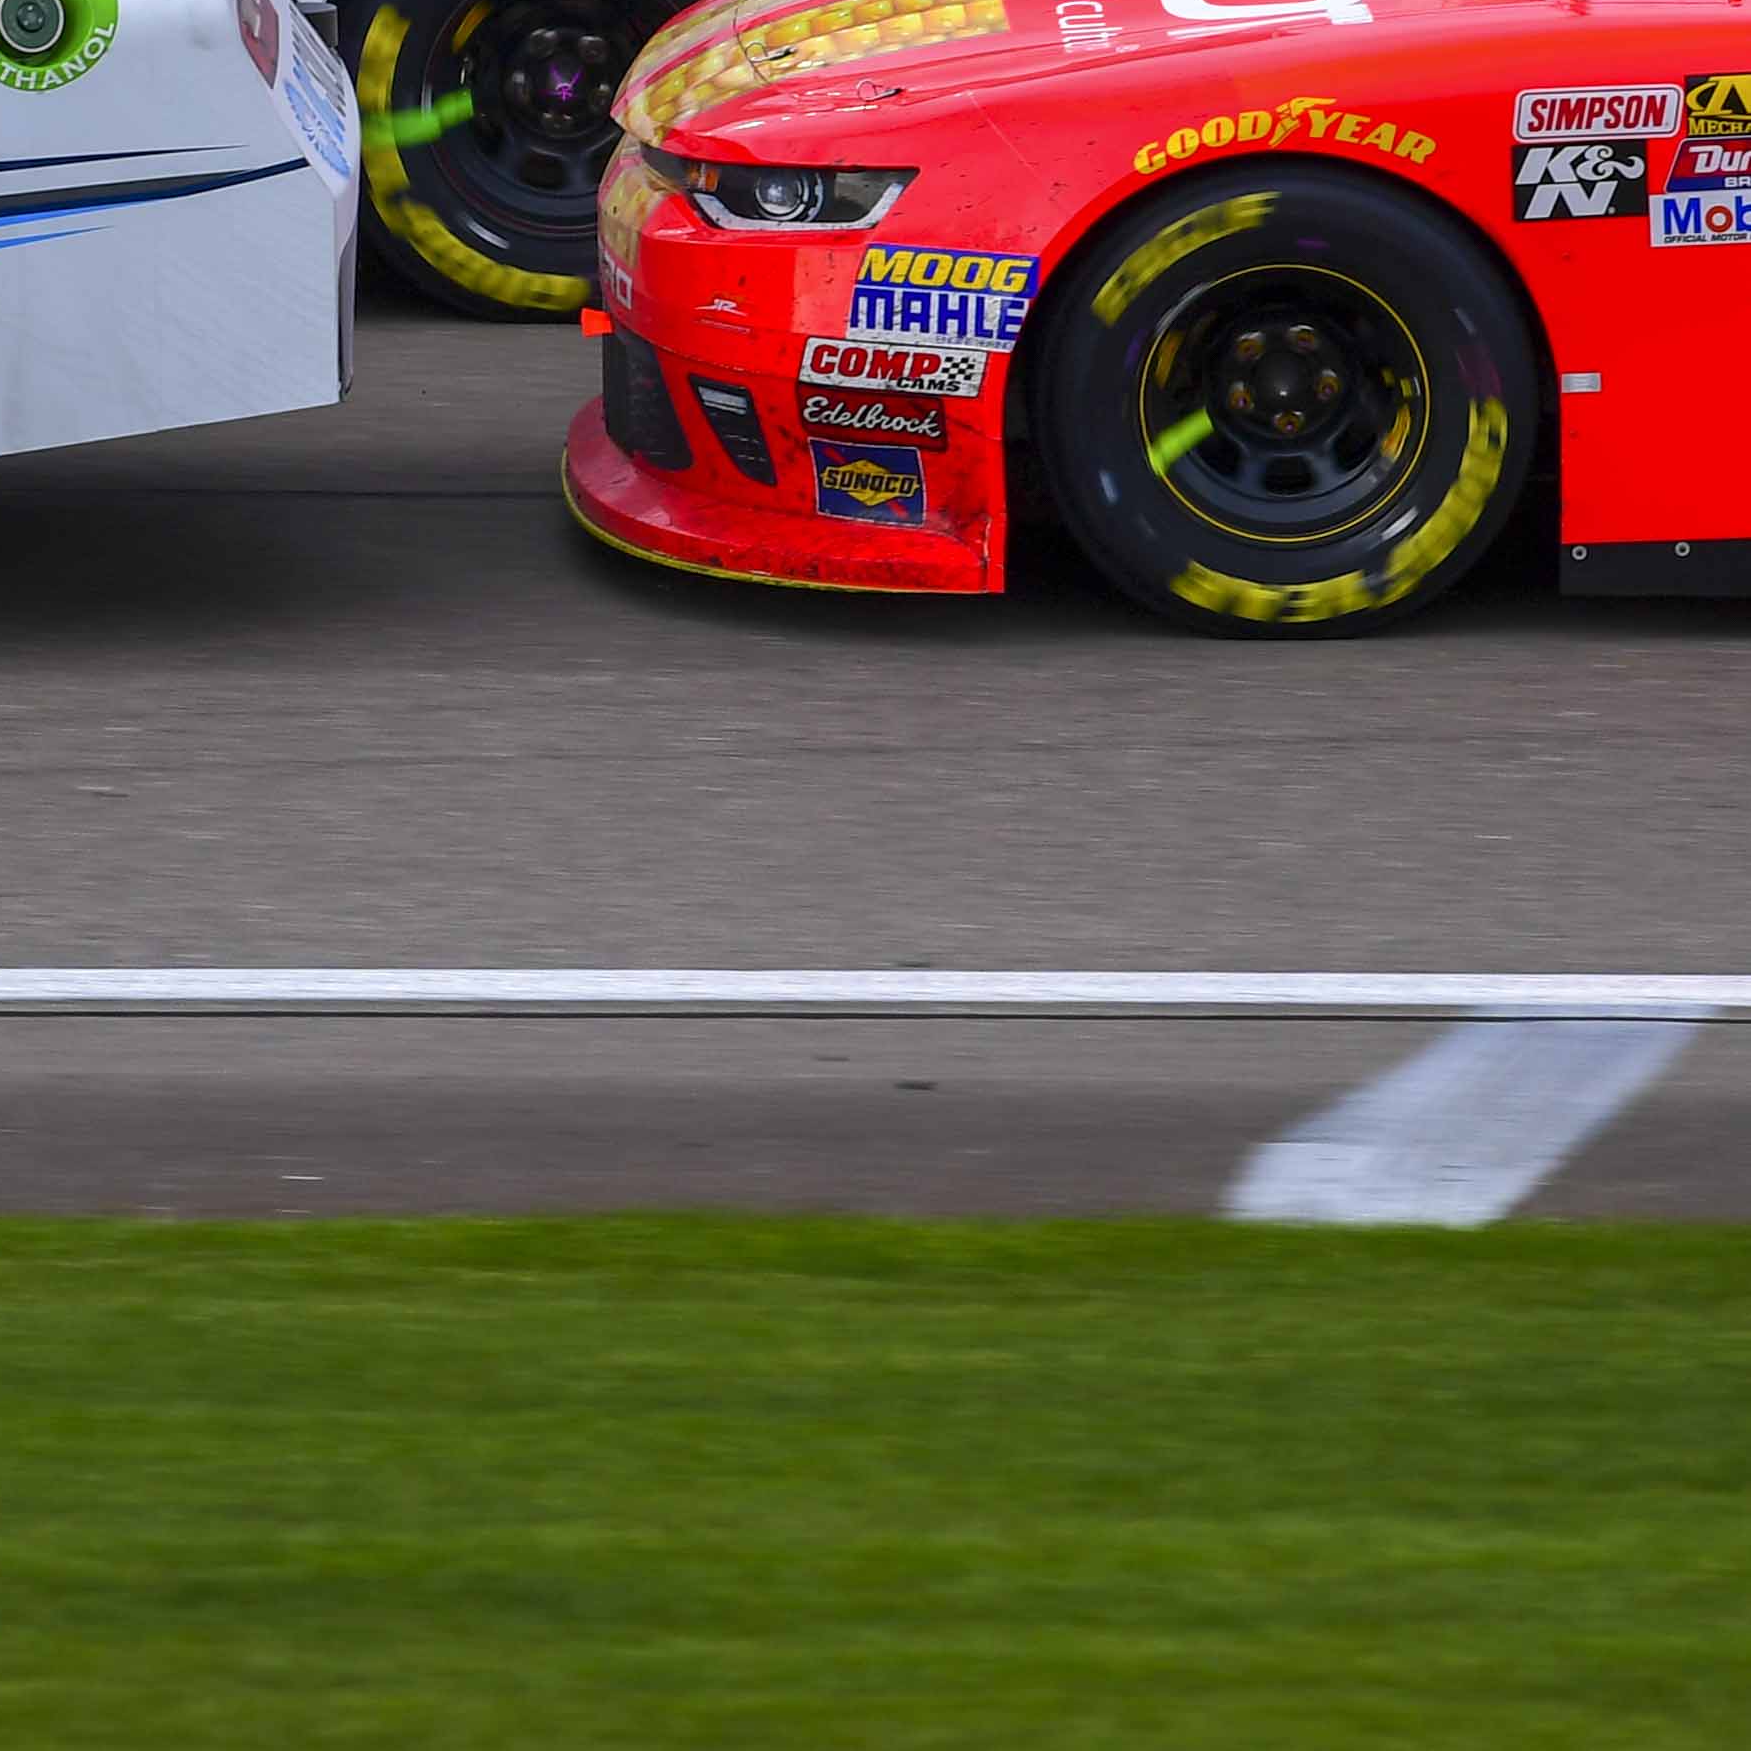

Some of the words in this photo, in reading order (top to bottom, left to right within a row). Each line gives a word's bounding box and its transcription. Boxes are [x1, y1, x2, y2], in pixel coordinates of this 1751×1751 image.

[1527, 94, 1668, 133] SIMPSON
[1663, 233, 1707, 244] OFFICIAL
[1710, 232, 1747, 242] MOTOR
[856, 247, 1034, 293] MOOG
[849, 286, 1026, 341] MAHLE
[810, 343, 942, 381] COMP
[897, 375, 963, 393] CAMS
[802, 396, 942, 438] Edelbrock
[823, 468, 918, 495] SUNOCO
